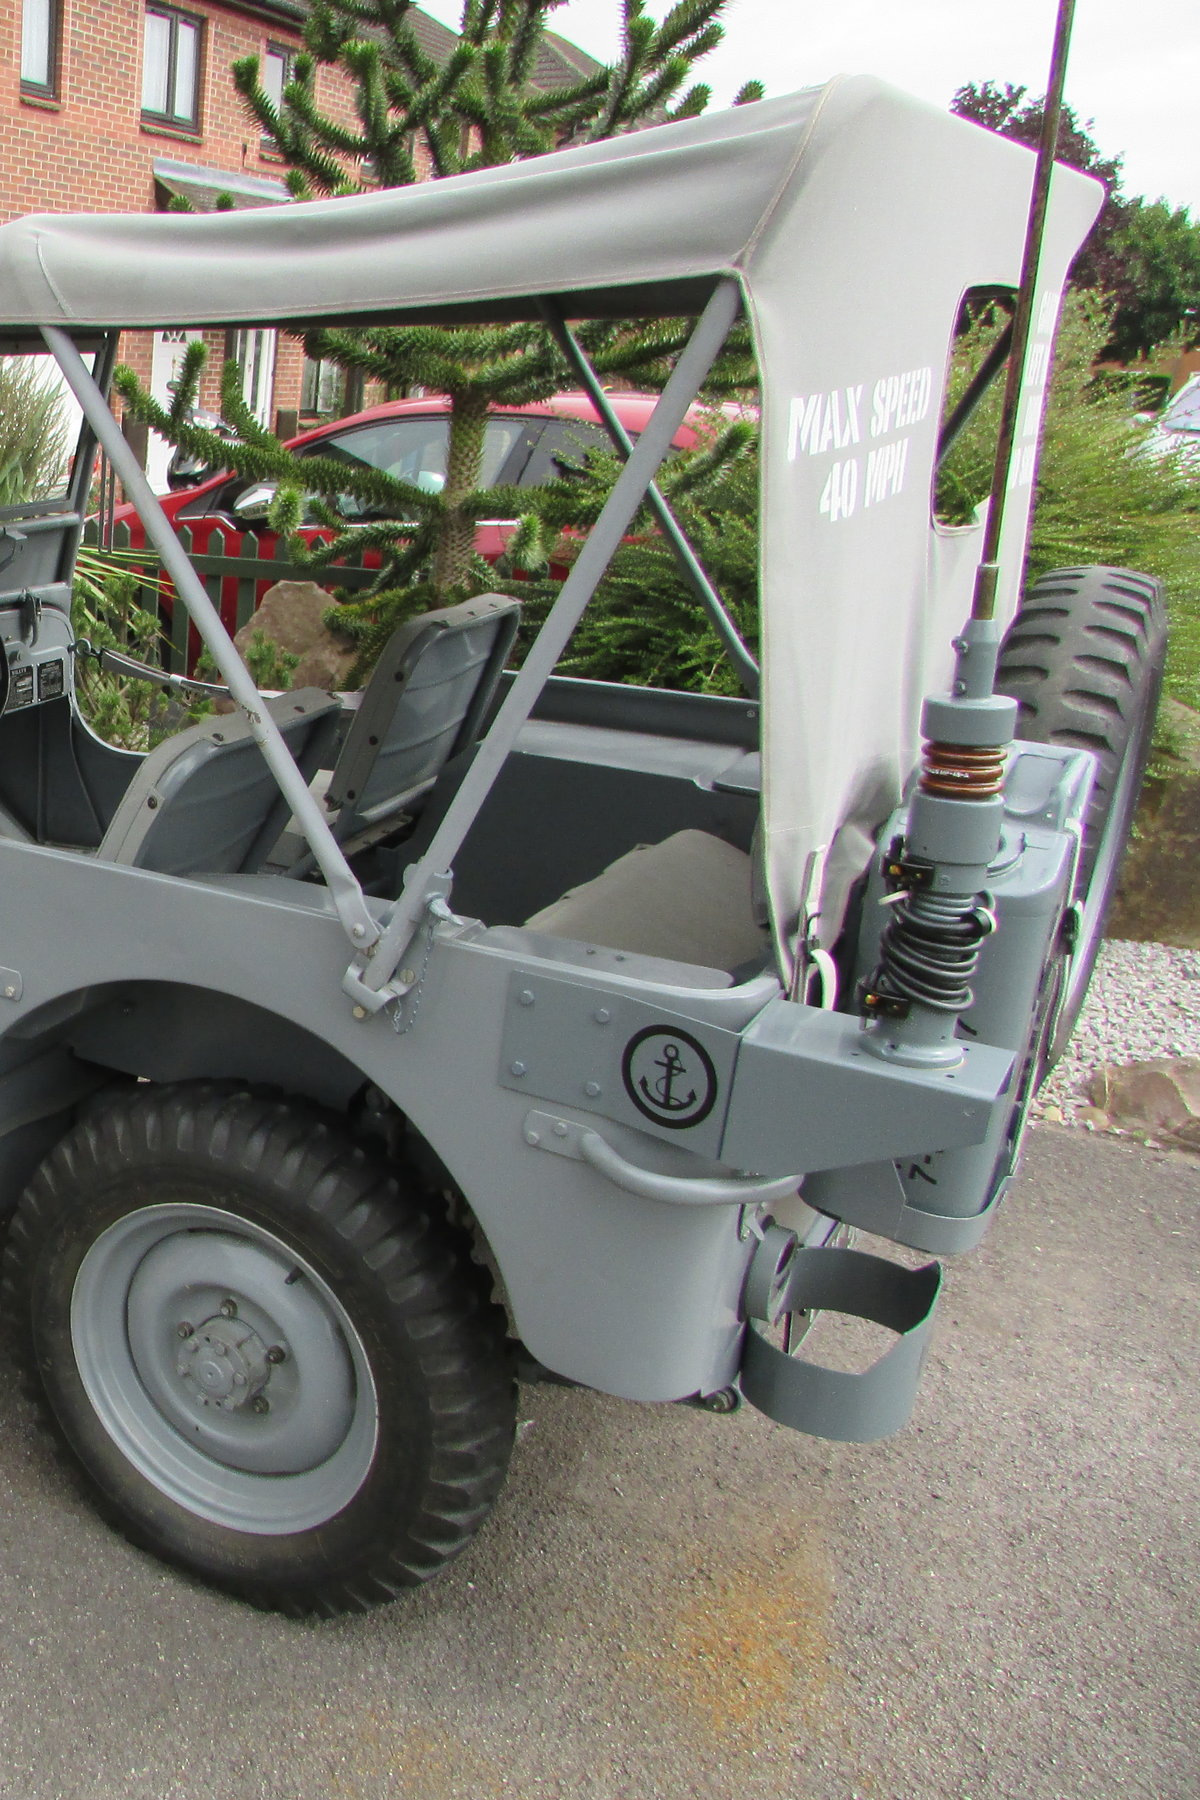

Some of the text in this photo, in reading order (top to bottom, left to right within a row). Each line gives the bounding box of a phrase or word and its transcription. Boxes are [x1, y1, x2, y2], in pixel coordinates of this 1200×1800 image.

[787, 366, 932, 463] MAX SPEED
[819, 437, 910, 522] 40 MPH
